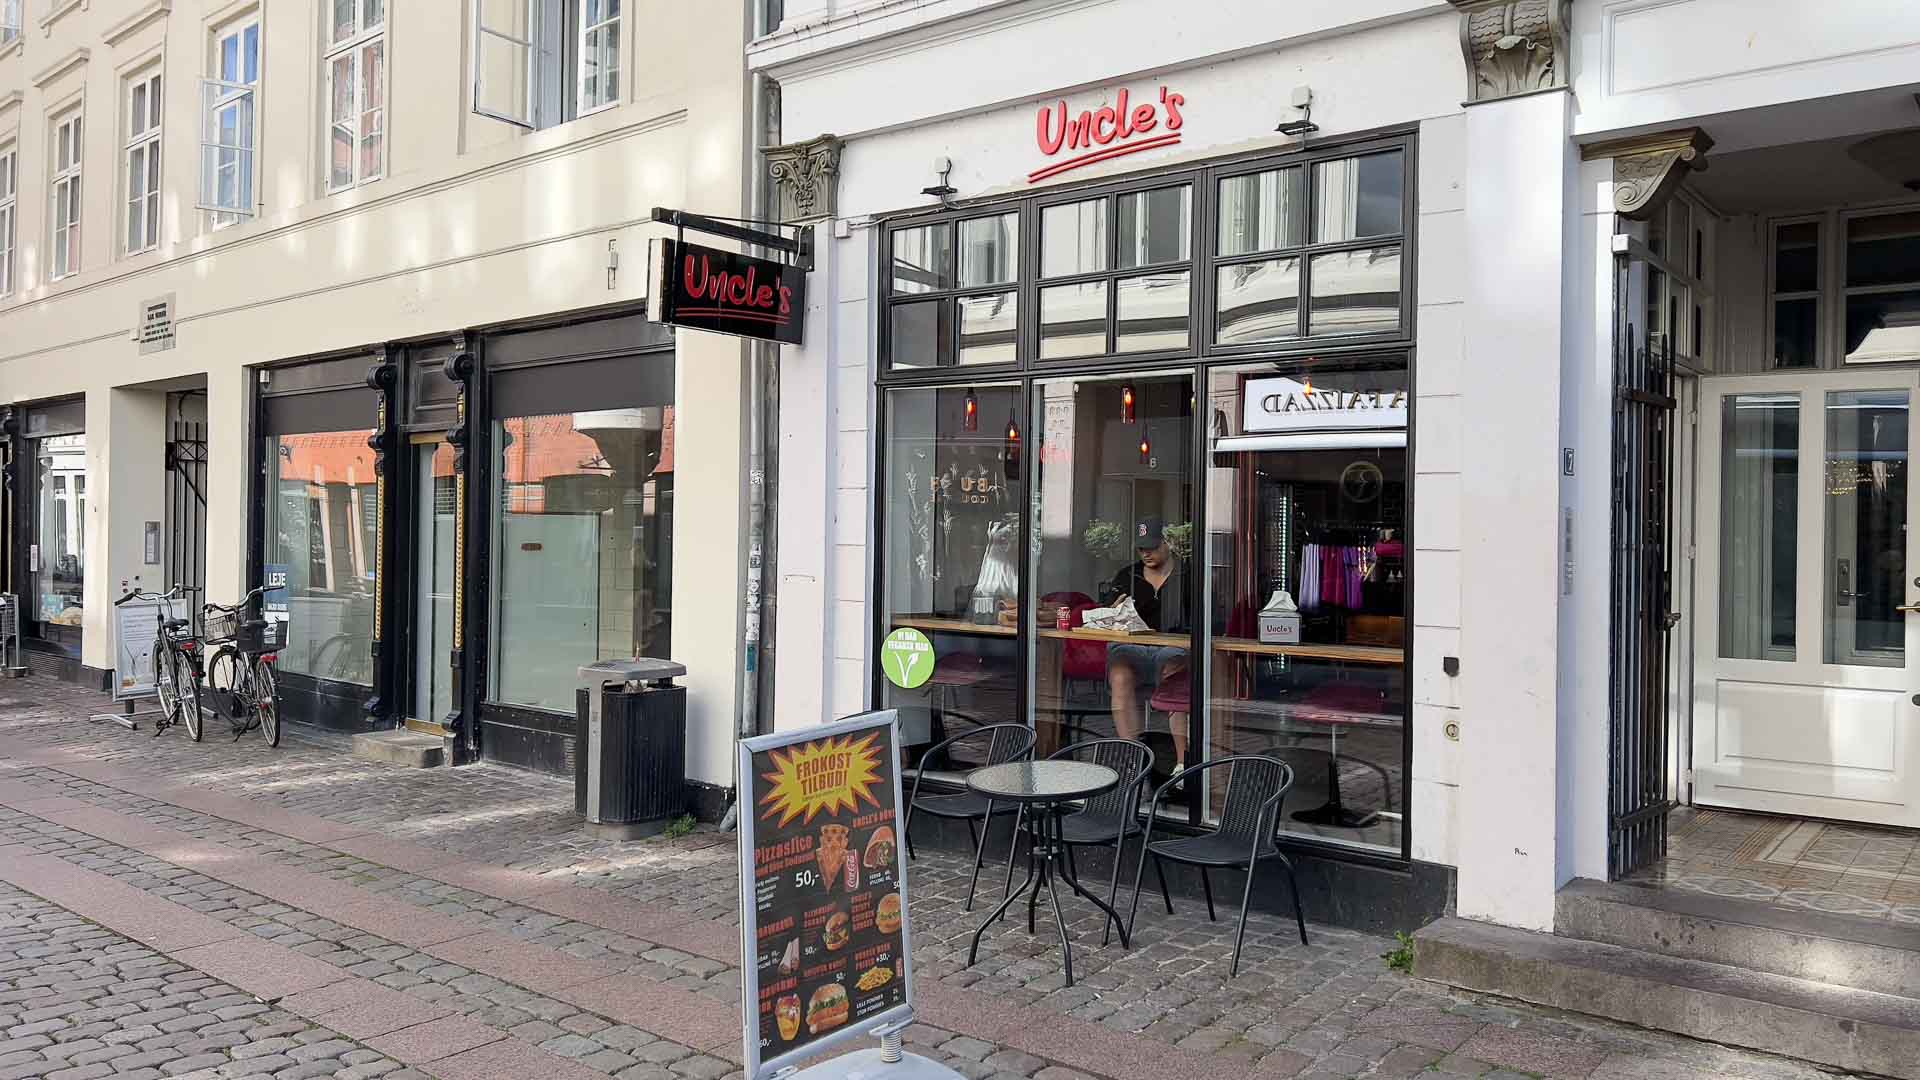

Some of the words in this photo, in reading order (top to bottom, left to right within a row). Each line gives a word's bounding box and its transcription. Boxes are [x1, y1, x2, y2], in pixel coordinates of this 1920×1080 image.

[1037, 86, 1185, 155] Uncle's
[684, 254, 792, 313] Uncle's
[795, 752, 852, 780] FROKOST
[795, 869, 820, 889] 50,-
